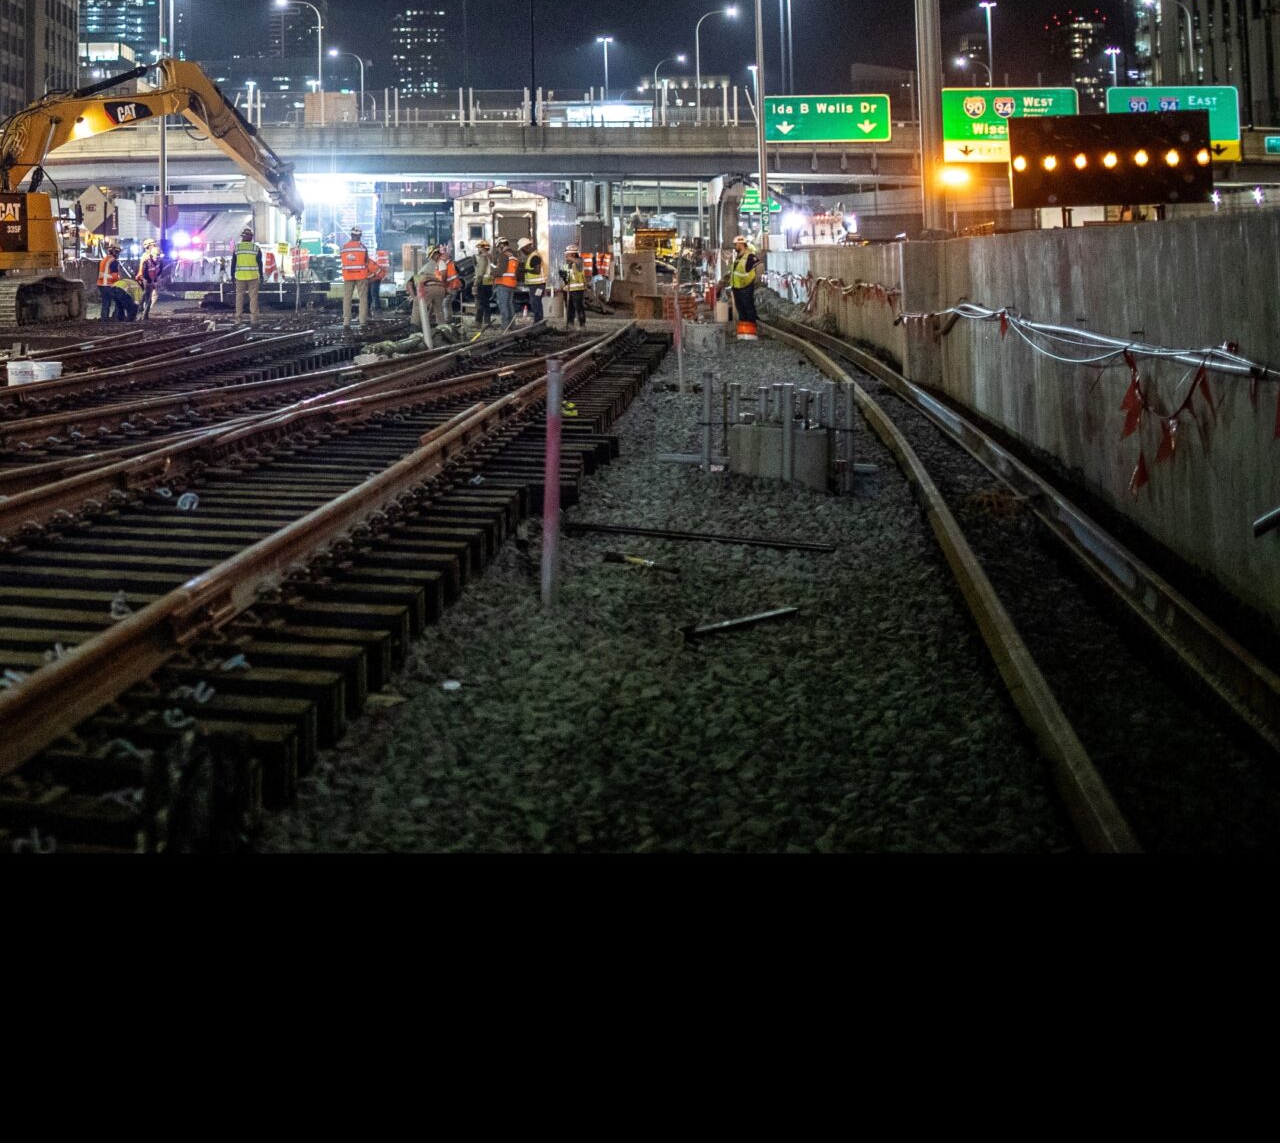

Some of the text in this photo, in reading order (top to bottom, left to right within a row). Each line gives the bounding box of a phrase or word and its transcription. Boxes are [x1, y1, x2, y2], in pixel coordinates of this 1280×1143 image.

[772, 102, 877, 114] Ida B Wells Dr
[966, 102, 983, 114] 90
[995, 103, 1012, 114] 94
[1130, 102, 1147, 112] 90
[1160, 101, 1176, 111] 94
[117, 103, 137, 123] CAT
